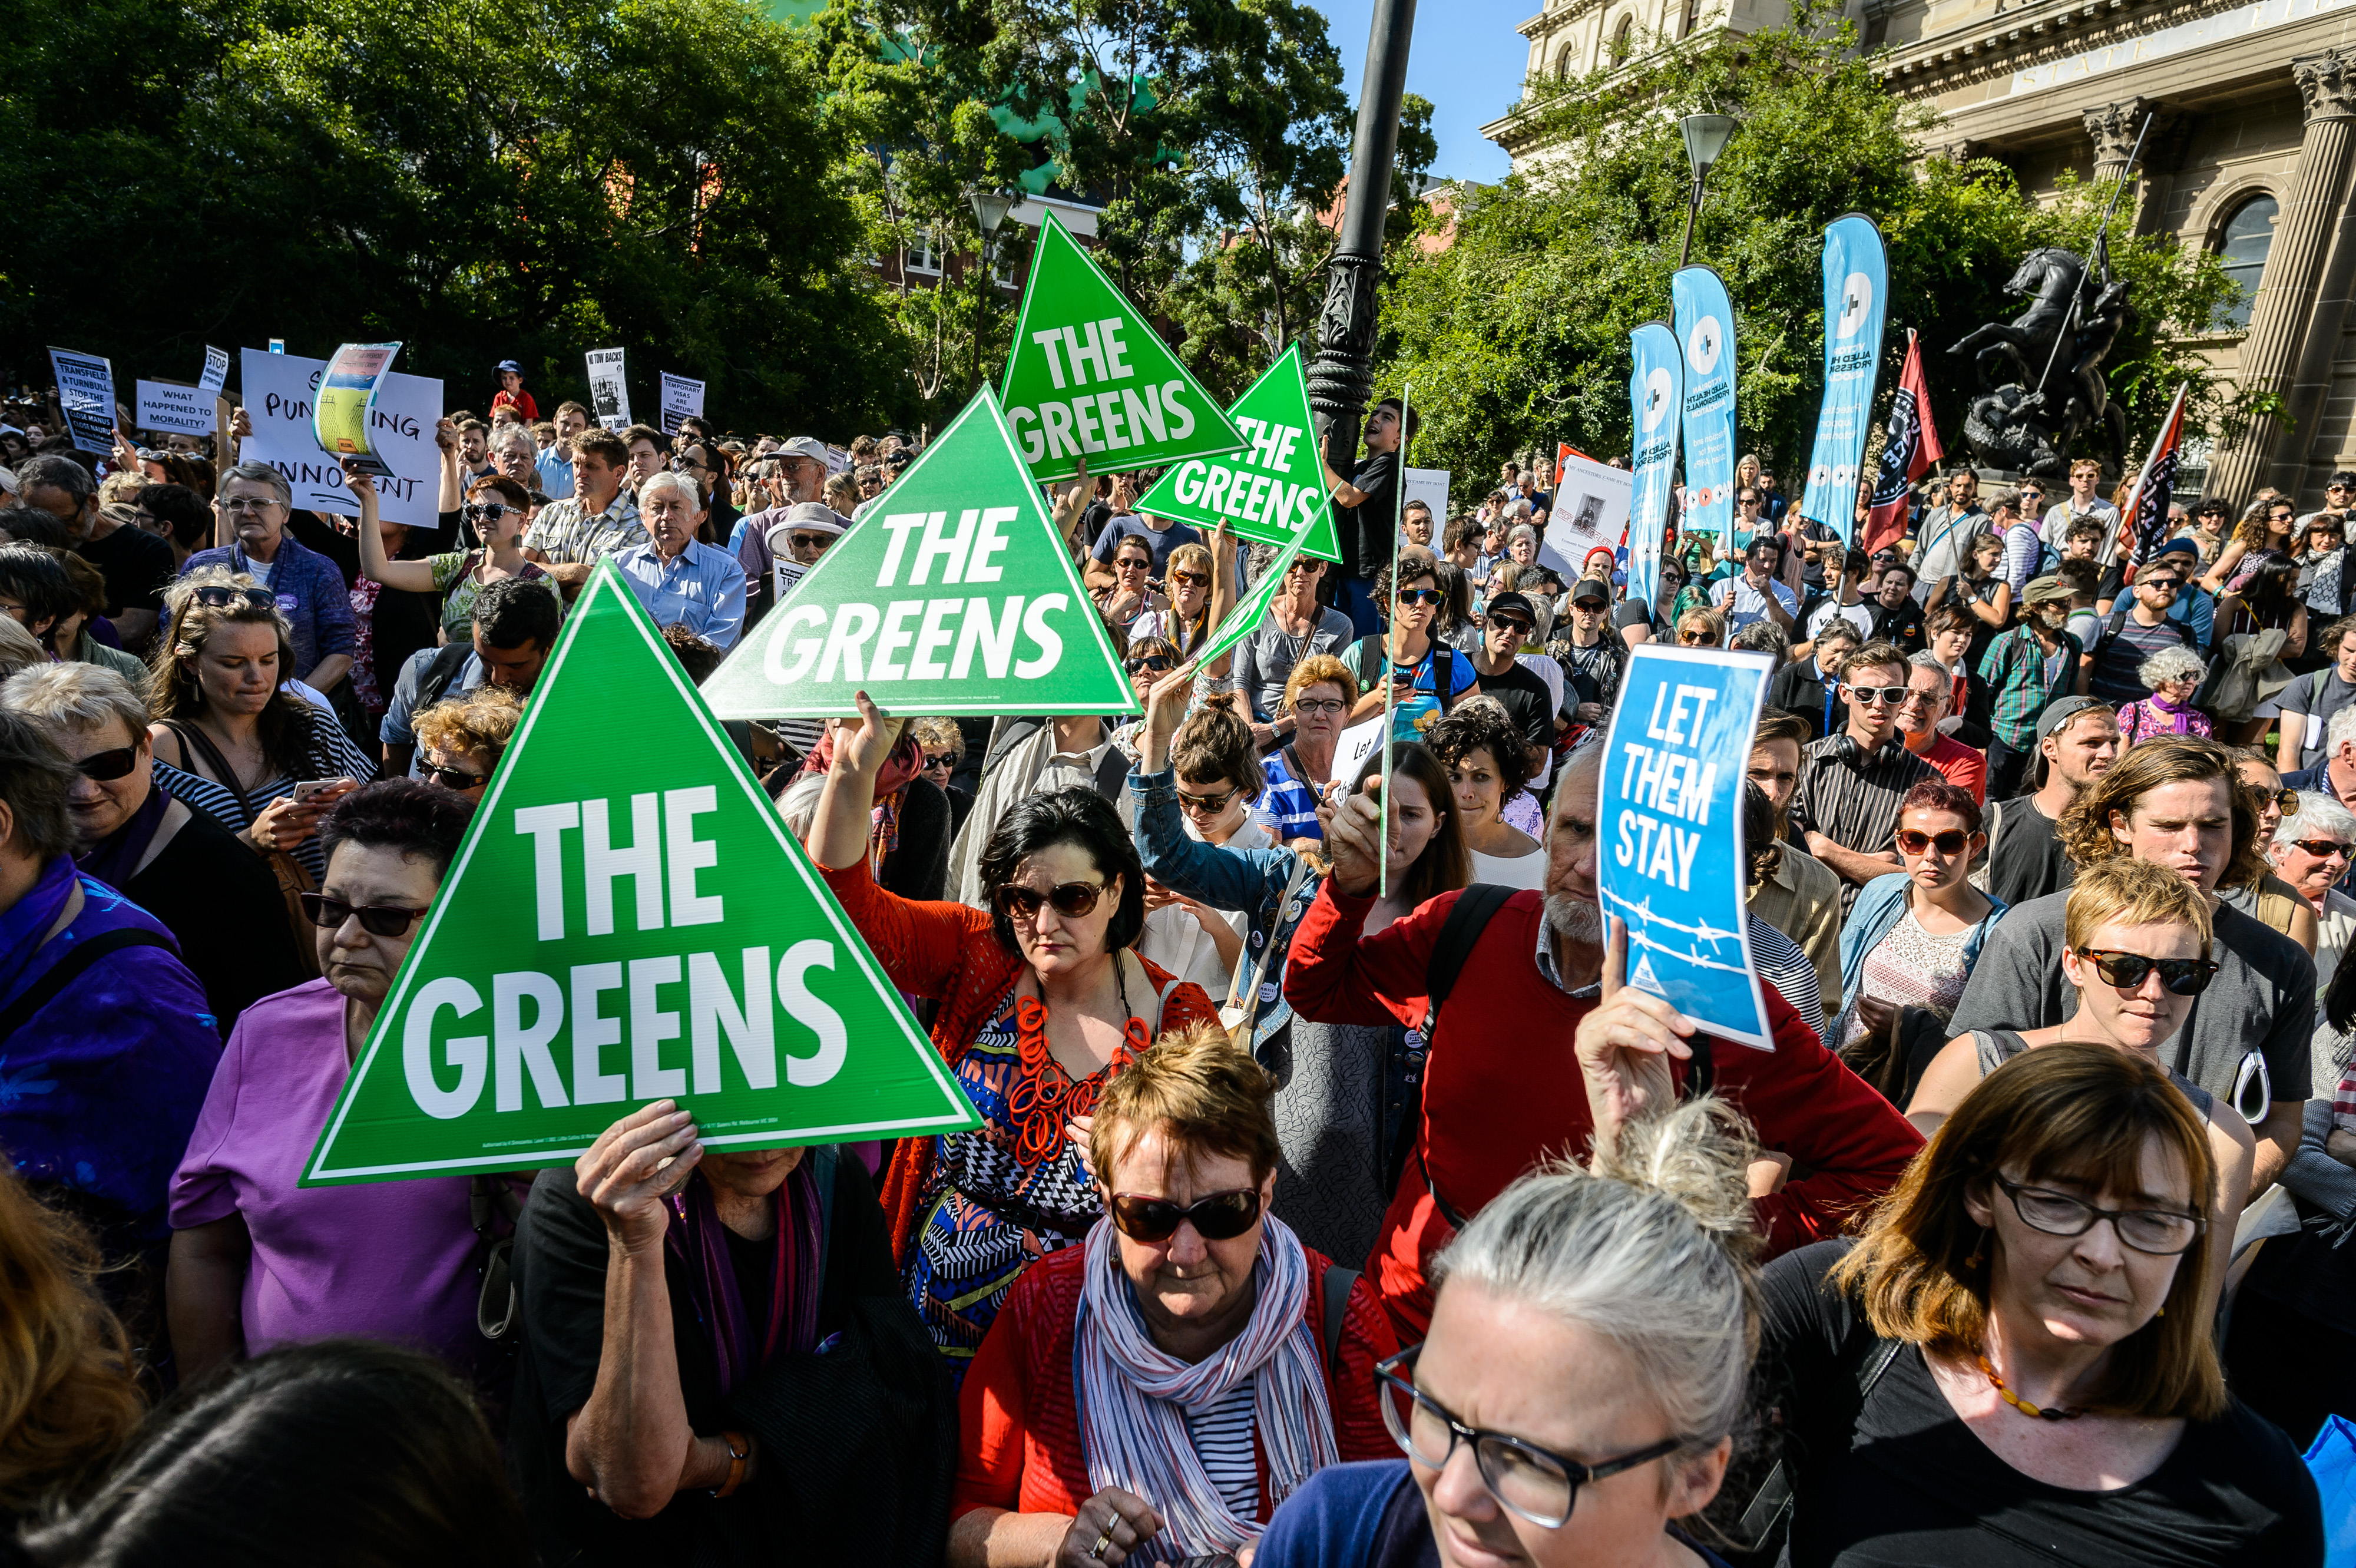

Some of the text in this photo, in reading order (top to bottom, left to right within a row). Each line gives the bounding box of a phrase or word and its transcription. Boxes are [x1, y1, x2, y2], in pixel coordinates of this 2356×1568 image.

[2020, 38, 2154, 91] STATE
[594, 353, 604, 364] TOW
[605, 351, 622, 362] BACKS
[1032, 316, 1134, 389] THE
[207, 354, 226, 370] STOP
[59, 365, 107, 381] TRANSFIELD
[68, 377, 110, 392] TURNBULL
[665, 381, 700, 393] TEMPORARY
[69, 388, 104, 403] STOP THE
[163, 391, 193, 401] WHAT
[674, 390, 690, 399] VISAS
[71, 399, 105, 413] TORTURE
[144, 401, 211, 416] HAPPENED TO
[669, 403, 694, 413] TORTURE
[70, 411, 110, 425] CLOSE MANUS
[150, 413, 205, 428] MORALITY?
[1005, 379, 1196, 465] GREENS
[74, 421, 111, 435] CLOSE NAURU
[1230, 414, 1302, 474] THE
[1576, 467, 1601, 479] ANCESTORS
[1603, 475, 1616, 484] CAME
[1174, 460, 1319, 533] GREENS
[1557, 510, 1612, 549] PEOPLE SMUGGLER
[875, 505, 1019, 588] THE
[782, 568, 801, 578] Refugee
[764, 593, 1068, 686] GREENS
[1646, 681, 1718, 749] LET
[1354, 738, 1372, 761] Let
[1620, 742, 1718, 826] THEM
[1615, 808, 1702, 892] STAY
[514, 785, 724, 941] THE
[402, 938, 848, 1120] GREENS
